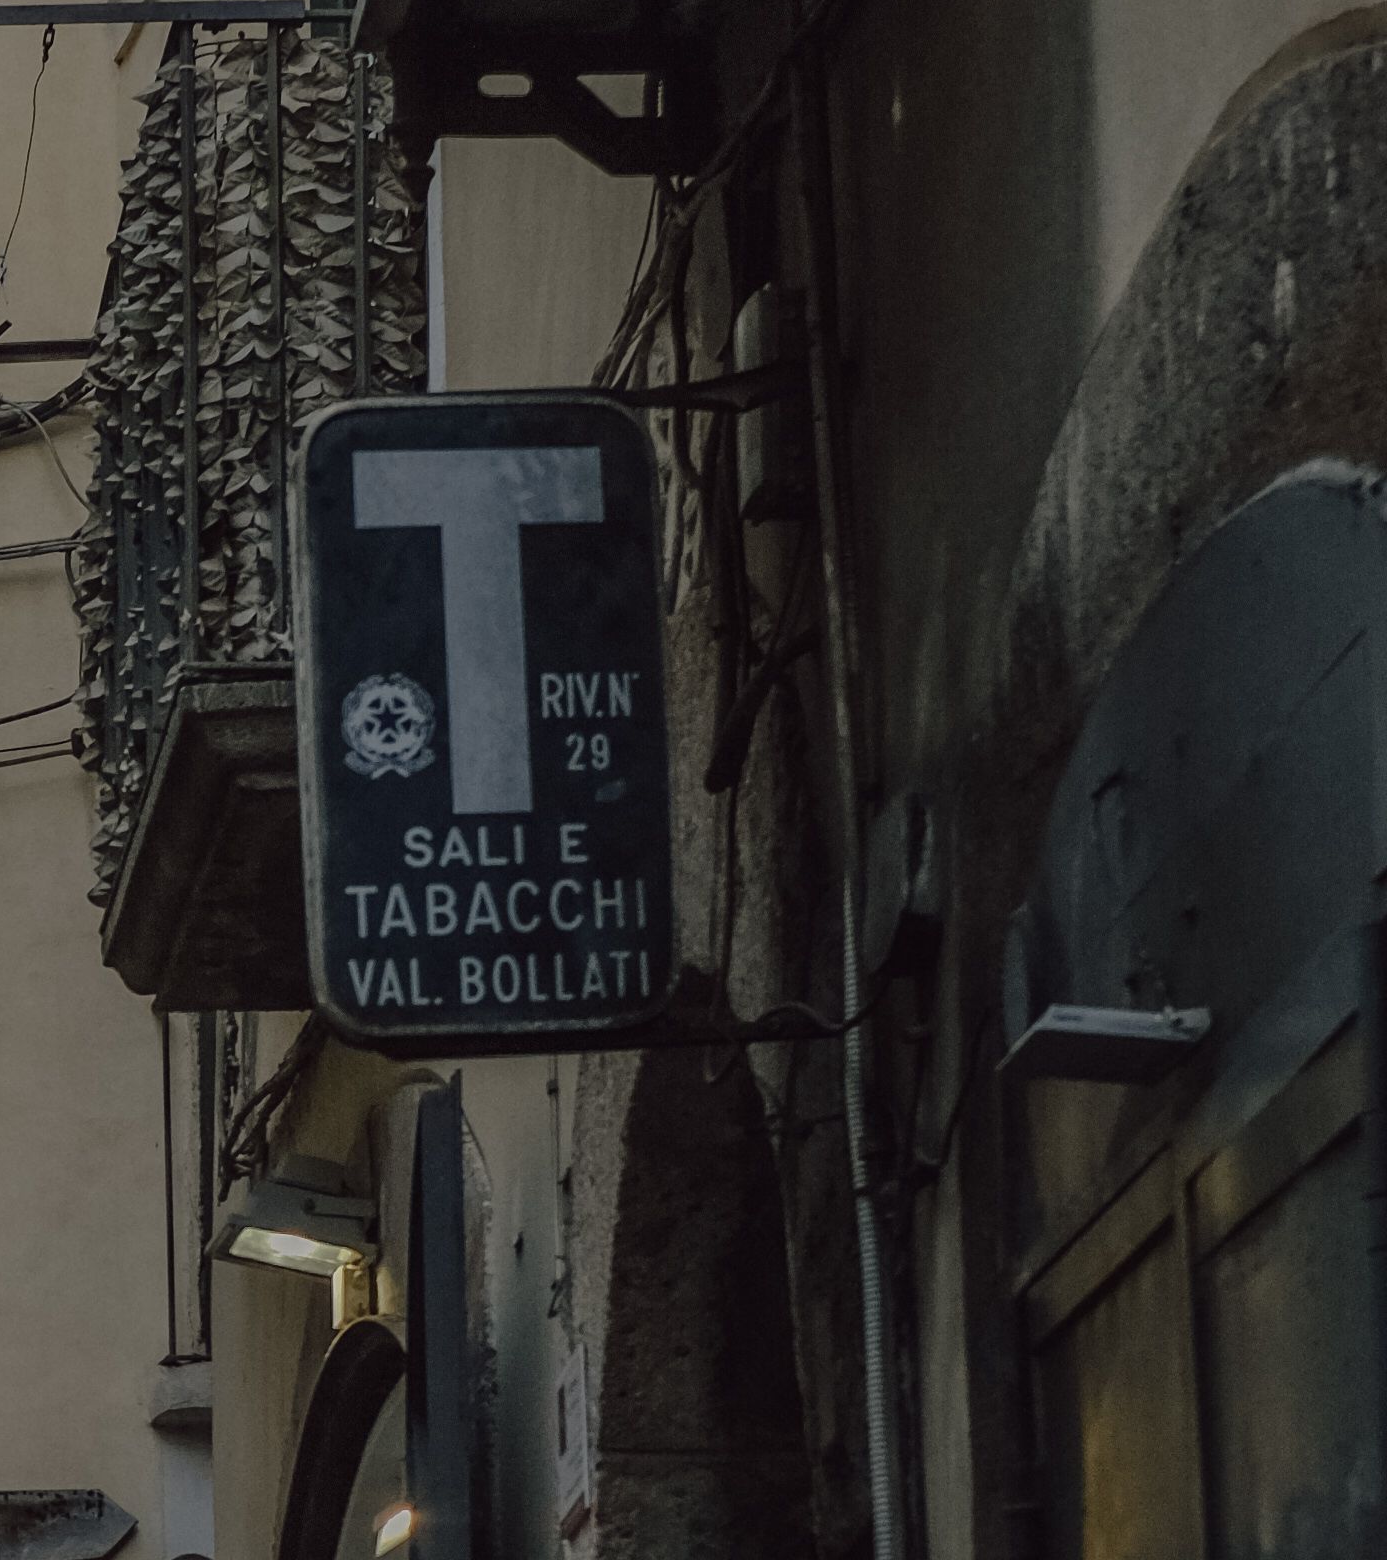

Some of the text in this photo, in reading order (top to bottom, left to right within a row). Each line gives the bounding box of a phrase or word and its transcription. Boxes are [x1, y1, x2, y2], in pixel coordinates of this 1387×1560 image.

[352, 446, 605, 814] T
[566, 733, 611, 772] 29
[403, 822, 590, 869] SALI E
[344, 877, 648, 939] TABACCHI
[347, 948, 651, 1008] VAL. BOLLATI
